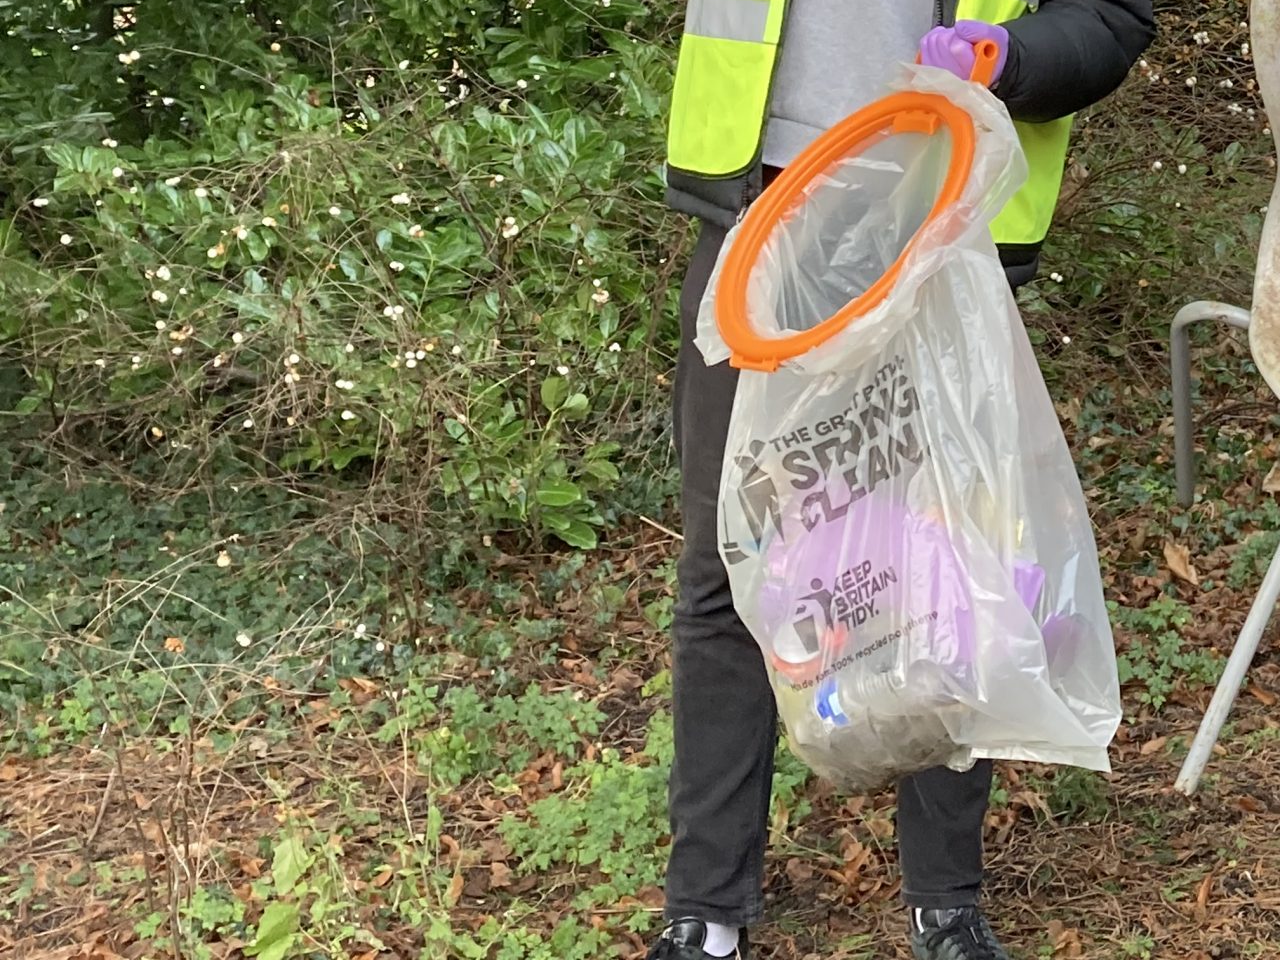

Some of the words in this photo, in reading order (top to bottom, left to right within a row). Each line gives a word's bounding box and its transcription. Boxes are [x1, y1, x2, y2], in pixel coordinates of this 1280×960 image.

[769, 427, 812, 453] THE
[833, 560, 872, 597] KEEP
[834, 566, 897, 616] BRITAIN
